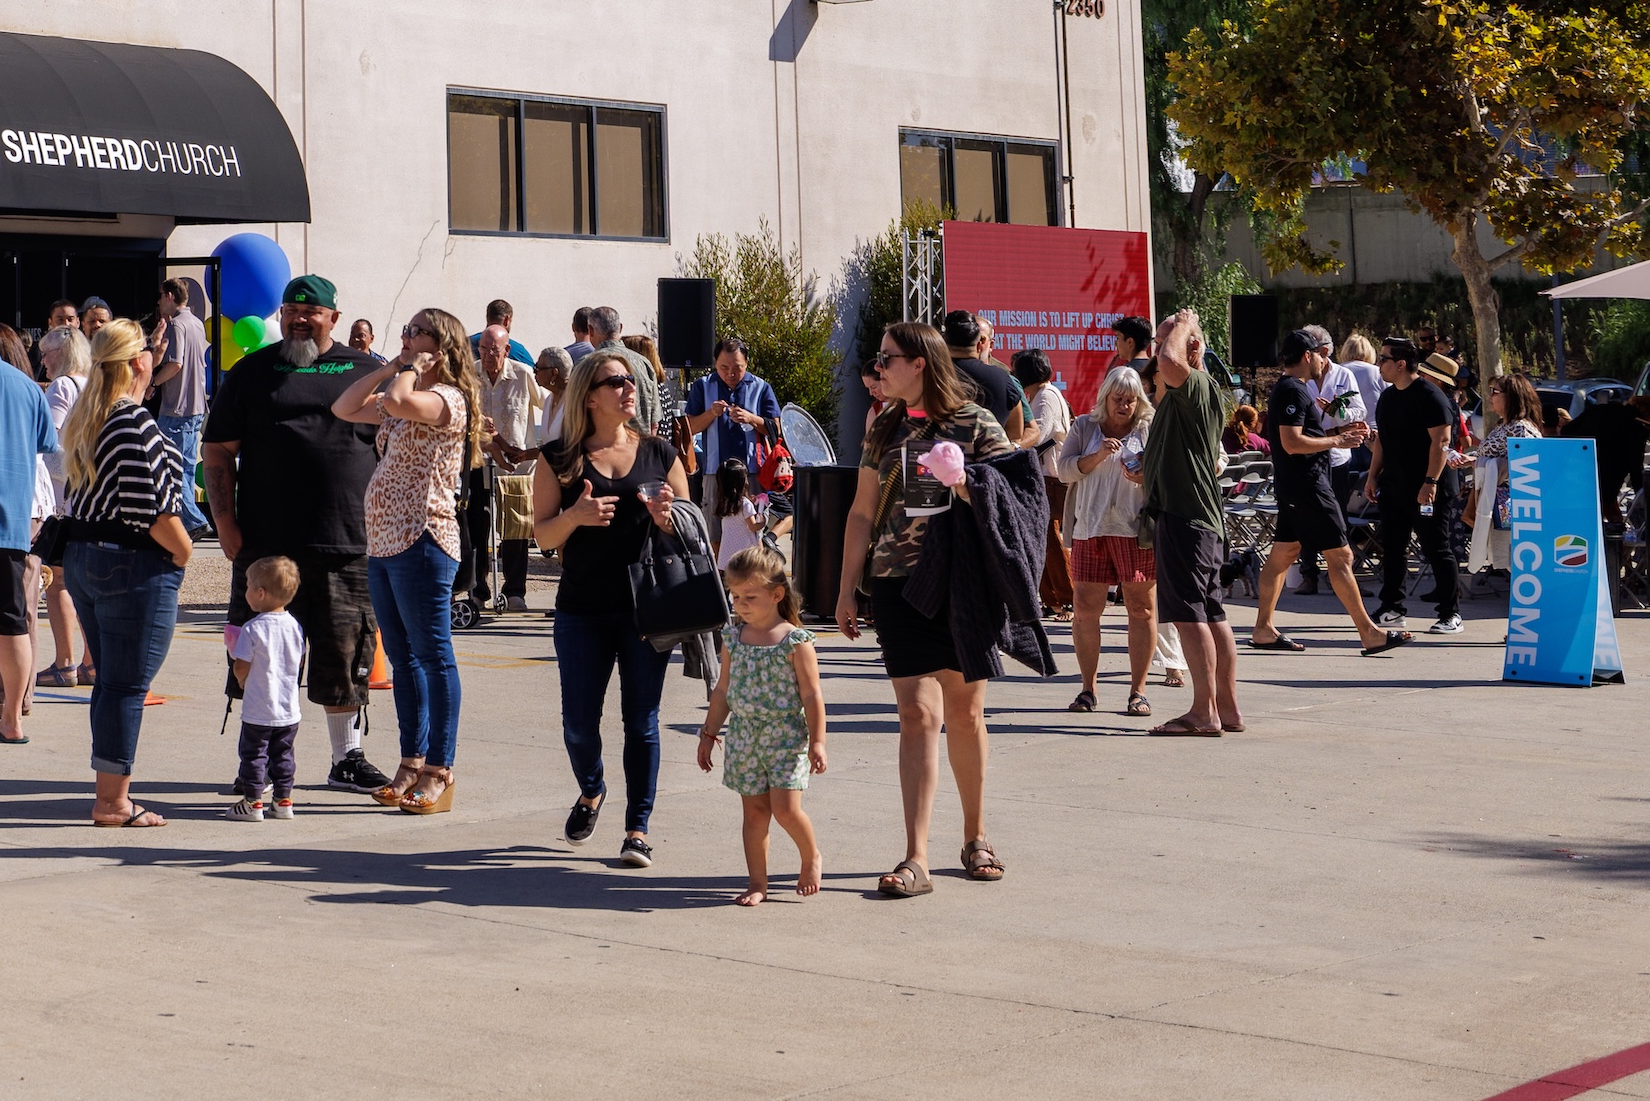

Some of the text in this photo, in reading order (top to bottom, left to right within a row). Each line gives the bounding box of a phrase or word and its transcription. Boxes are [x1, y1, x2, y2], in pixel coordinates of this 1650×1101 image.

[1, 129, 242, 177] SHEPHERDCHURCH
[999, 311, 1037, 327] MISSION
[1039, 311, 1049, 327] IS
[1050, 312, 1061, 328] TO
[1062, 312, 1080, 328] LIFT
[1082, 313, 1093, 329] UP
[1006, 334, 1024, 350] THE
[1025, 334, 1057, 350] WORLD
[1058, 335, 1085, 351] MIGHT
[319, 361, 354, 375] Heights
[1507, 454, 1543, 667] WELCOME
